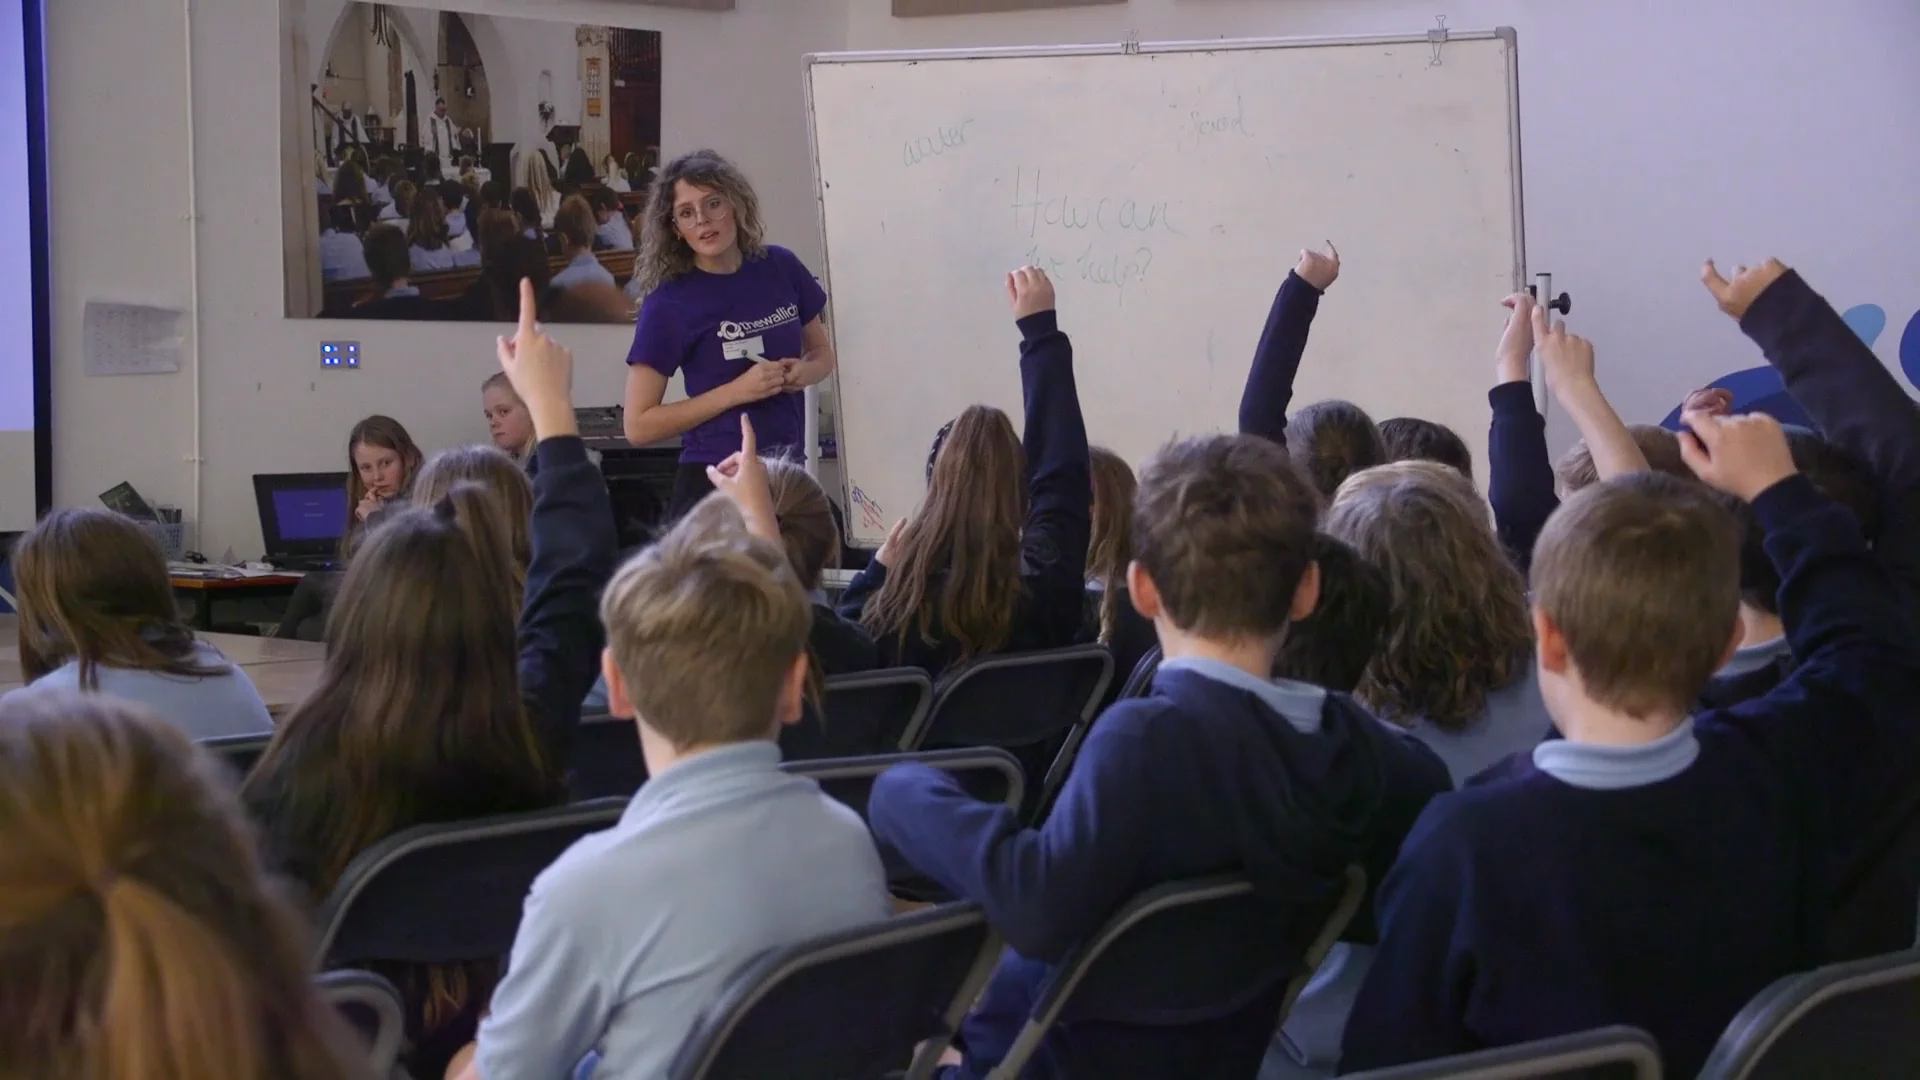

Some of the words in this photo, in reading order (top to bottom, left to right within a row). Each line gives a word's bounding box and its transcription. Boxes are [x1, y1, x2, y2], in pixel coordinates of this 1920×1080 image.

[904, 118, 974, 167] water
[1011, 165, 1090, 238] How
[1097, 197, 1189, 237] can
